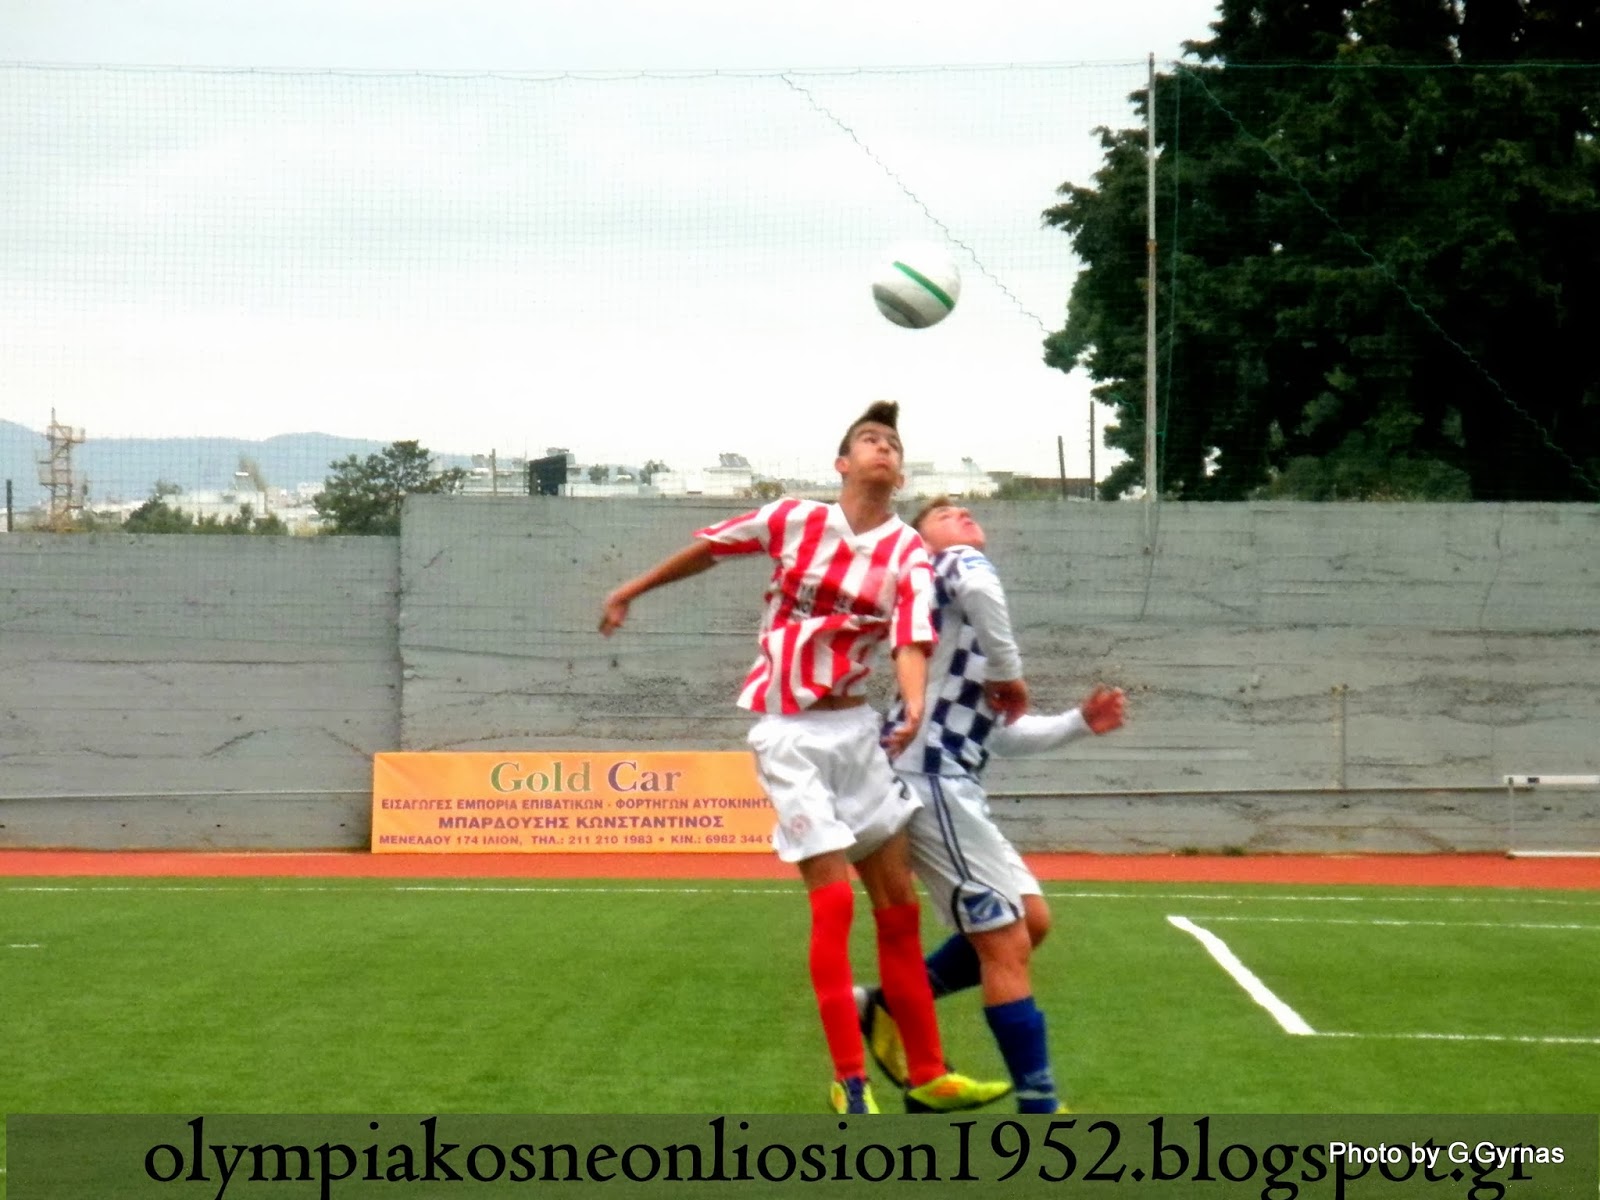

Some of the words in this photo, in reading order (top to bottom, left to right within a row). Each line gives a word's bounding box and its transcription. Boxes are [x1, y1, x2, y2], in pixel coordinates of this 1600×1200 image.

[490, 761, 591, 793] Gold
[607, 761, 682, 792] Car
[381, 799, 452, 810] ΕΙΣΑΓΩΓΕΣ
[456, 799, 518, 810] ΕΜΠΟΡΙΑ
[521, 799, 603, 810] ΕΠΙΒΑΤΙΚΩΝ
[615, 798, 688, 809] ΦΟΡΤΗΓΩΝ
[438, 816, 570, 829] ΜΠΑΡΔΟΥΣΗΣ
[576, 815, 724, 829] ΚΩΝΣΤΑΝΤΙΝΟΣ
[379, 835, 451, 845] ΜΕΝΕΛΑΟΥ
[456, 835, 479, 845] 174
[568, 835, 590, 845] 211
[595, 835, 618, 845] 210
[624, 835, 653, 845] 1983
[740, 834, 763, 844] 344
